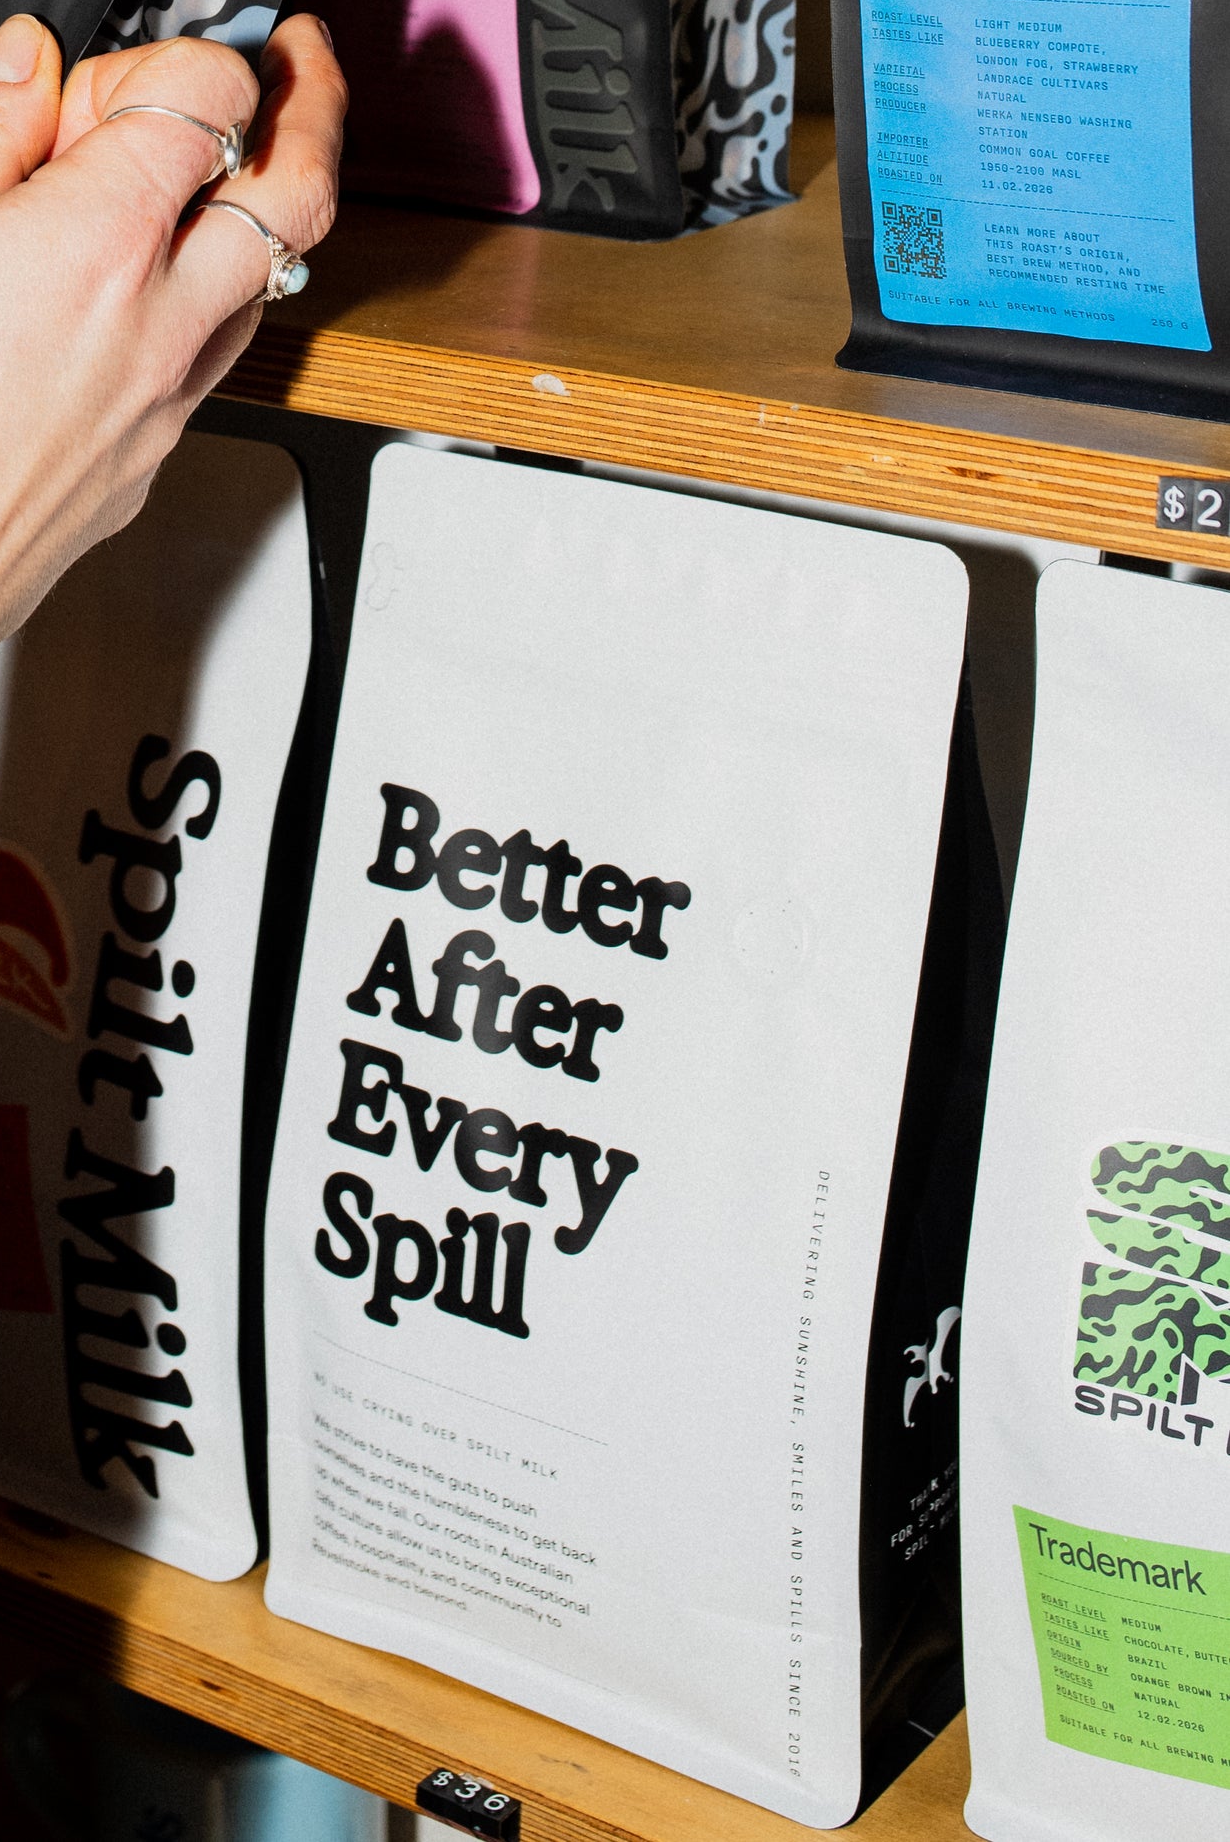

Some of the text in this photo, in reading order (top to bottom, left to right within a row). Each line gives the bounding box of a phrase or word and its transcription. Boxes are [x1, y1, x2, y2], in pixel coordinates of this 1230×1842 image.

[872, 11, 943, 27] ROAST LEVEL
[975, 19, 1062, 33] LIGHT MEDIUM
[872, 29, 944, 44] TASTES LIKE
[976, 37, 1106, 55] BLUEBERRY COMPOTE,
[976, 55, 1138, 74] LONDON FOG, STRAWBERRY
[981, 163, 1081, 179] 1950-2100 MASL
[981, 180, 1053, 194] 11.02.2026
[989, 269, 1165, 294] RECOMMENDED RESTING TIME
[366, 781, 691, 959] Better
[345, 917, 625, 1082] After
[57, 733, 222, 1501] Spilt Milk
[326, 1037, 639, 1255] Every
[313, 1170, 531, 1340] Spill
[1074, 1384, 1214, 1451] SPILT
[467, 1438, 559, 1480] SPILT MILK
[788, 1170, 830, 1777] DELIVERING SUNSHINE, SMILES AND SPILLS SINCE 2016
[449, 1476, 538, 1519] guts to push
[1029, 1523, 1206, 1595] Trademark
[1122, 1617, 1162, 1632] MEDIUM
[1124, 1636, 1190, 1659] CHOCOLATE,
[1128, 1654, 1168, 1670] BRAZIL
[1137, 1710, 1205, 1733] 12.02.2026
[432, 1771, 510, 1811] $36
